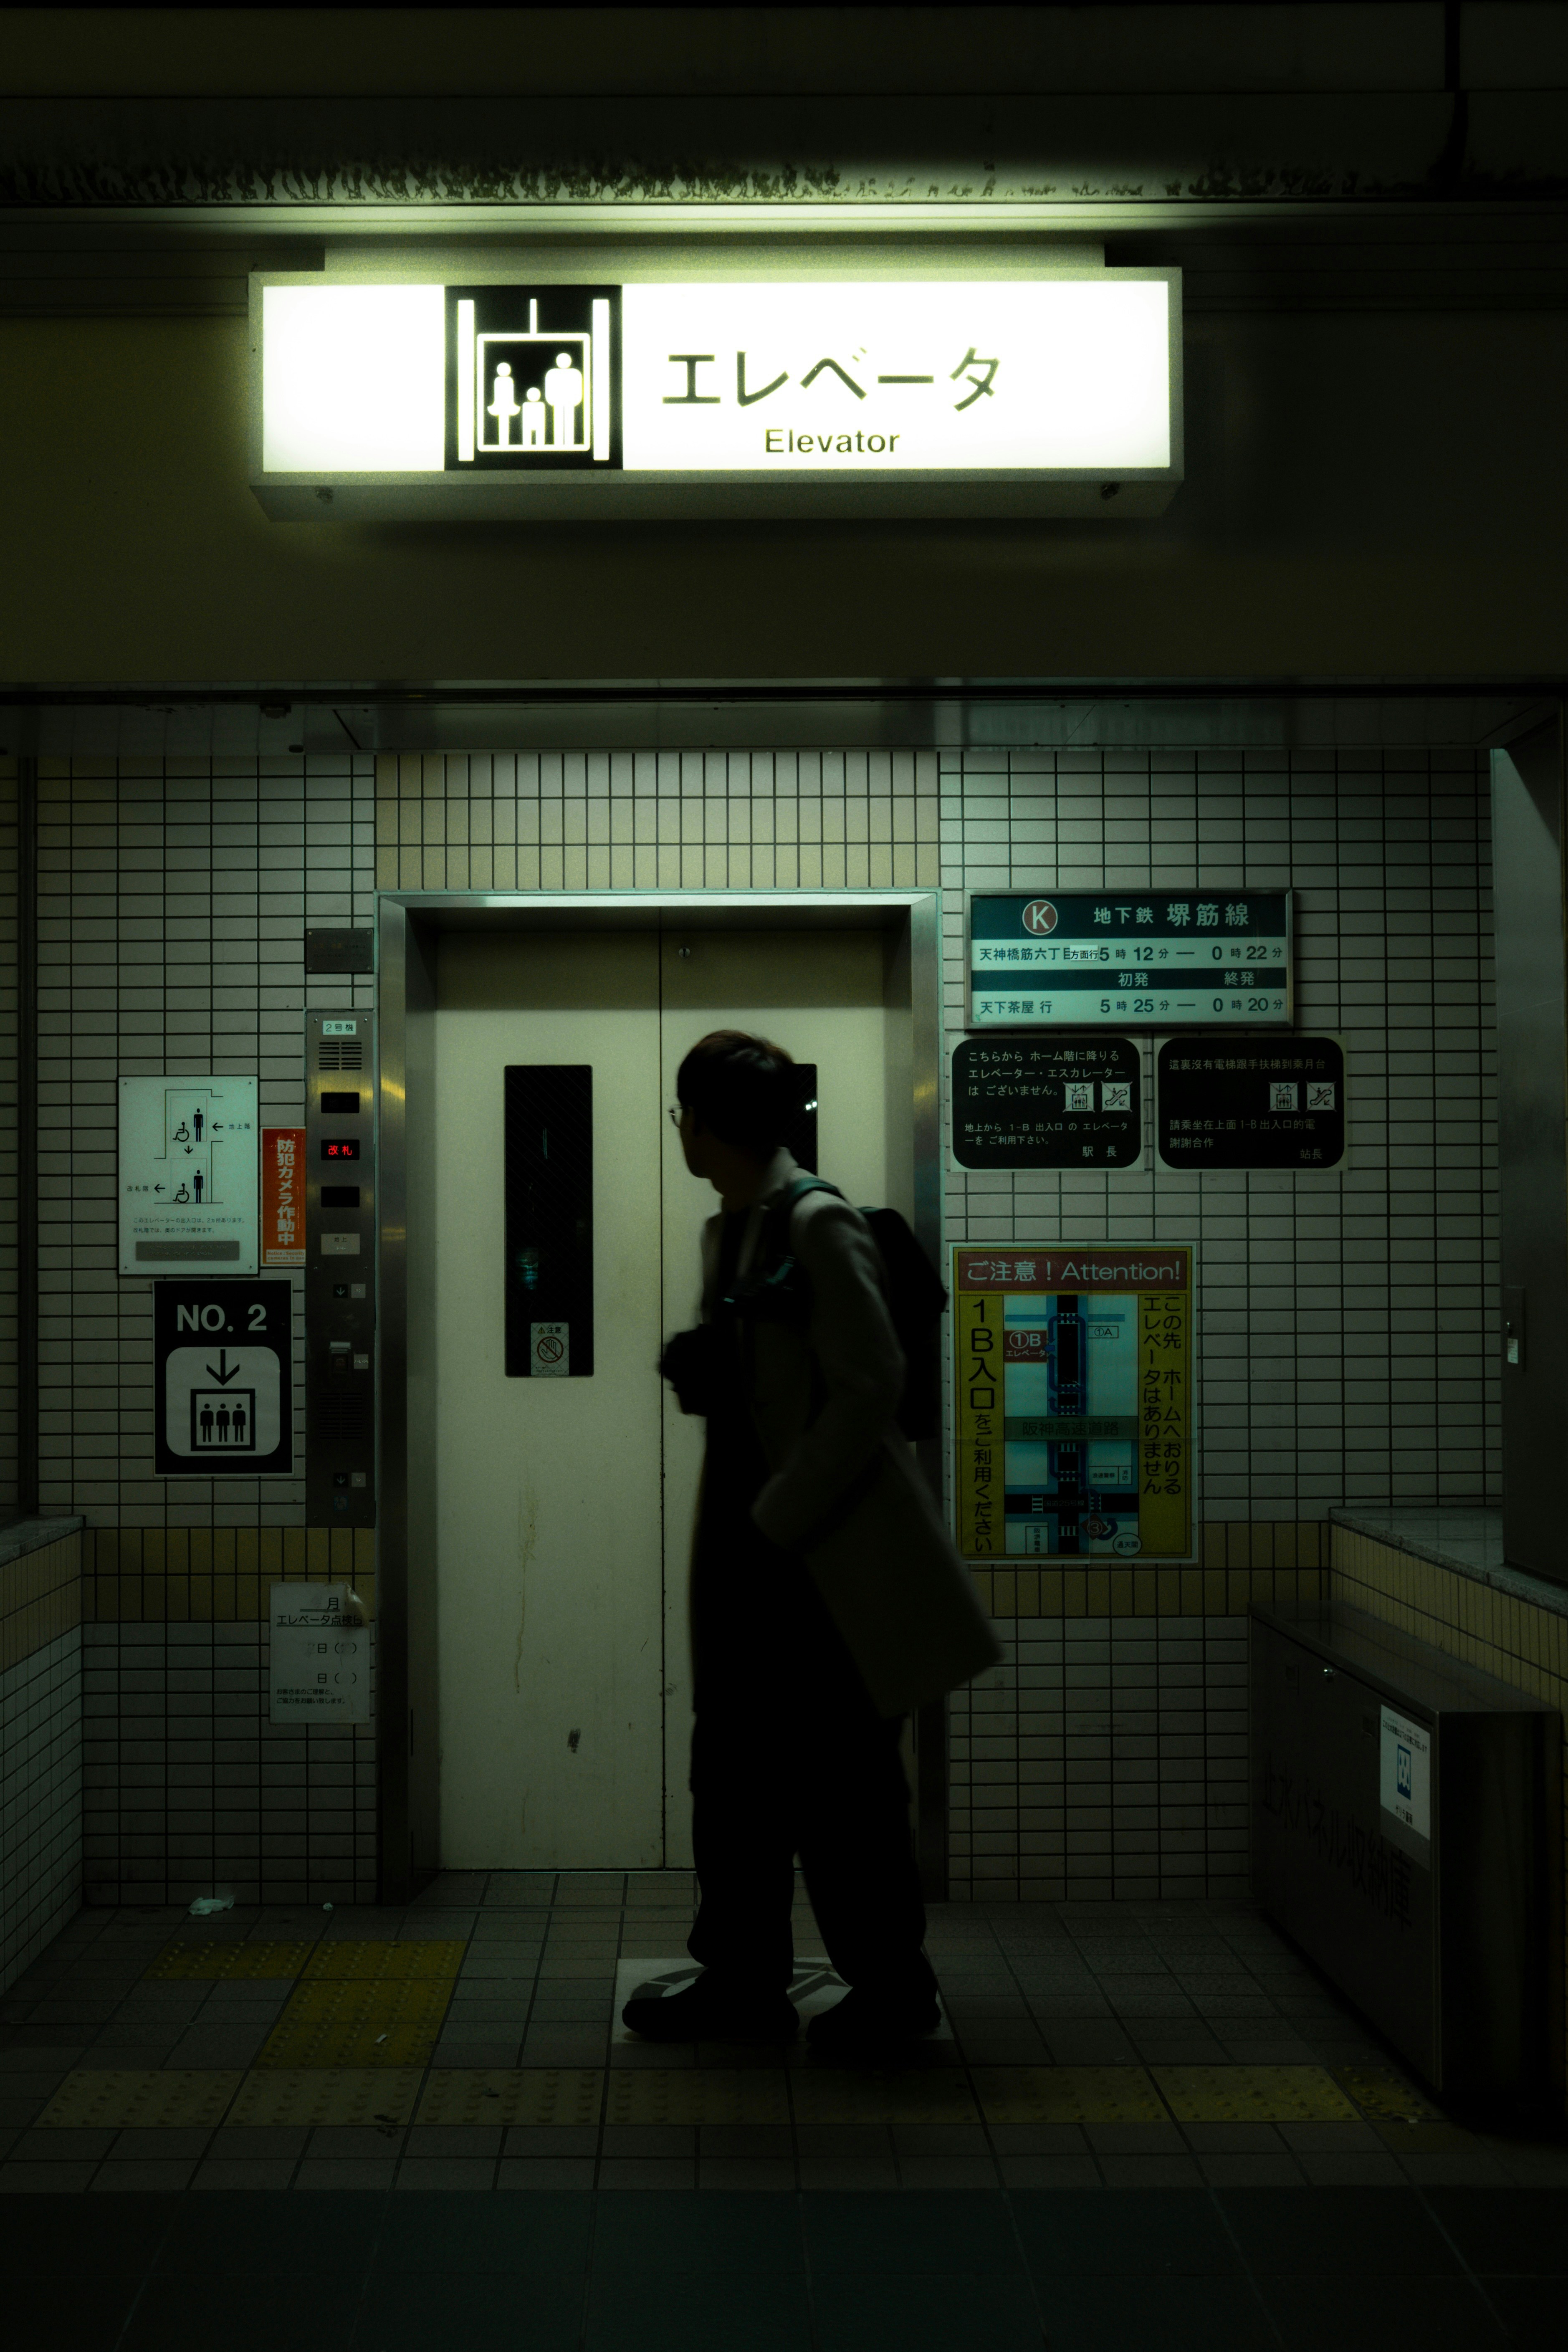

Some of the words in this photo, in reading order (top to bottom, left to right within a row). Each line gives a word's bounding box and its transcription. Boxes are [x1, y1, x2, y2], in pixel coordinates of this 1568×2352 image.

[663, 347, 1000, 412] エレベータ
[766, 429, 900, 453] Elevator
[1093, 907, 1154, 925] 地下鉄
[1167, 903, 1249, 927] 堺筋線
[1118, 972, 1149, 988] 初発
[1224, 971, 1255, 986] 終発
[326, 1023, 353, 1032] 2号機
[328, 1145, 353, 1156] 改札
[1169, 1137, 1214, 1149] 謝謝合作
[1299, 1148, 1323, 1160] 站長
[277, 1139, 296, 1246] 防犯カメラ作動中
[1060, 1260, 1181, 1281] Attention!
[177, 1304, 234, 1332] NO.
[247, 1304, 267, 1331] 2
[1022, 1421, 1119, 1436] 阪神高速道路
[327, 1597, 339, 1609] 月
